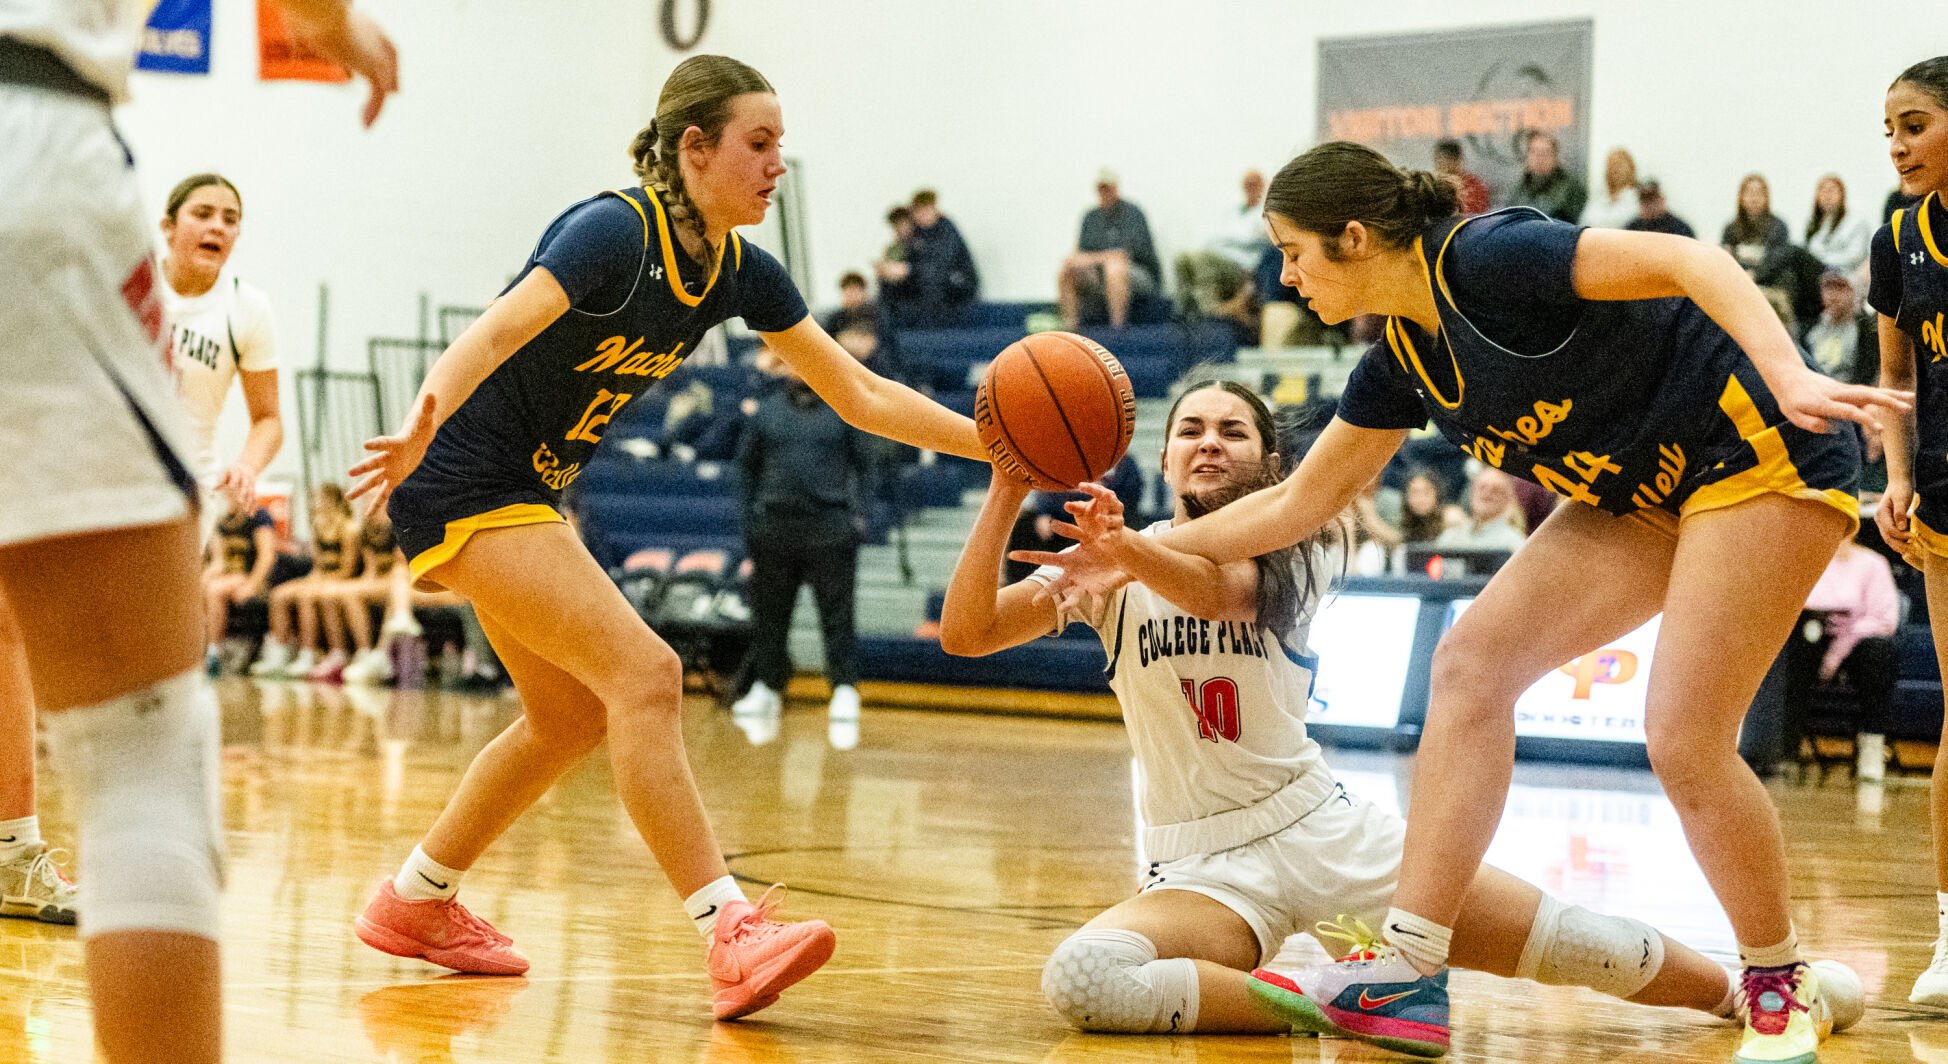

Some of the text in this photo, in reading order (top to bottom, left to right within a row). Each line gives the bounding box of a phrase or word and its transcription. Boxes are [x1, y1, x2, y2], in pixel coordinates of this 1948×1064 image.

[573, 335, 685, 379] Nache
[564, 388, 633, 444] 12
[1531, 451, 1622, 506] 44
[1179, 676, 1242, 743] 10
